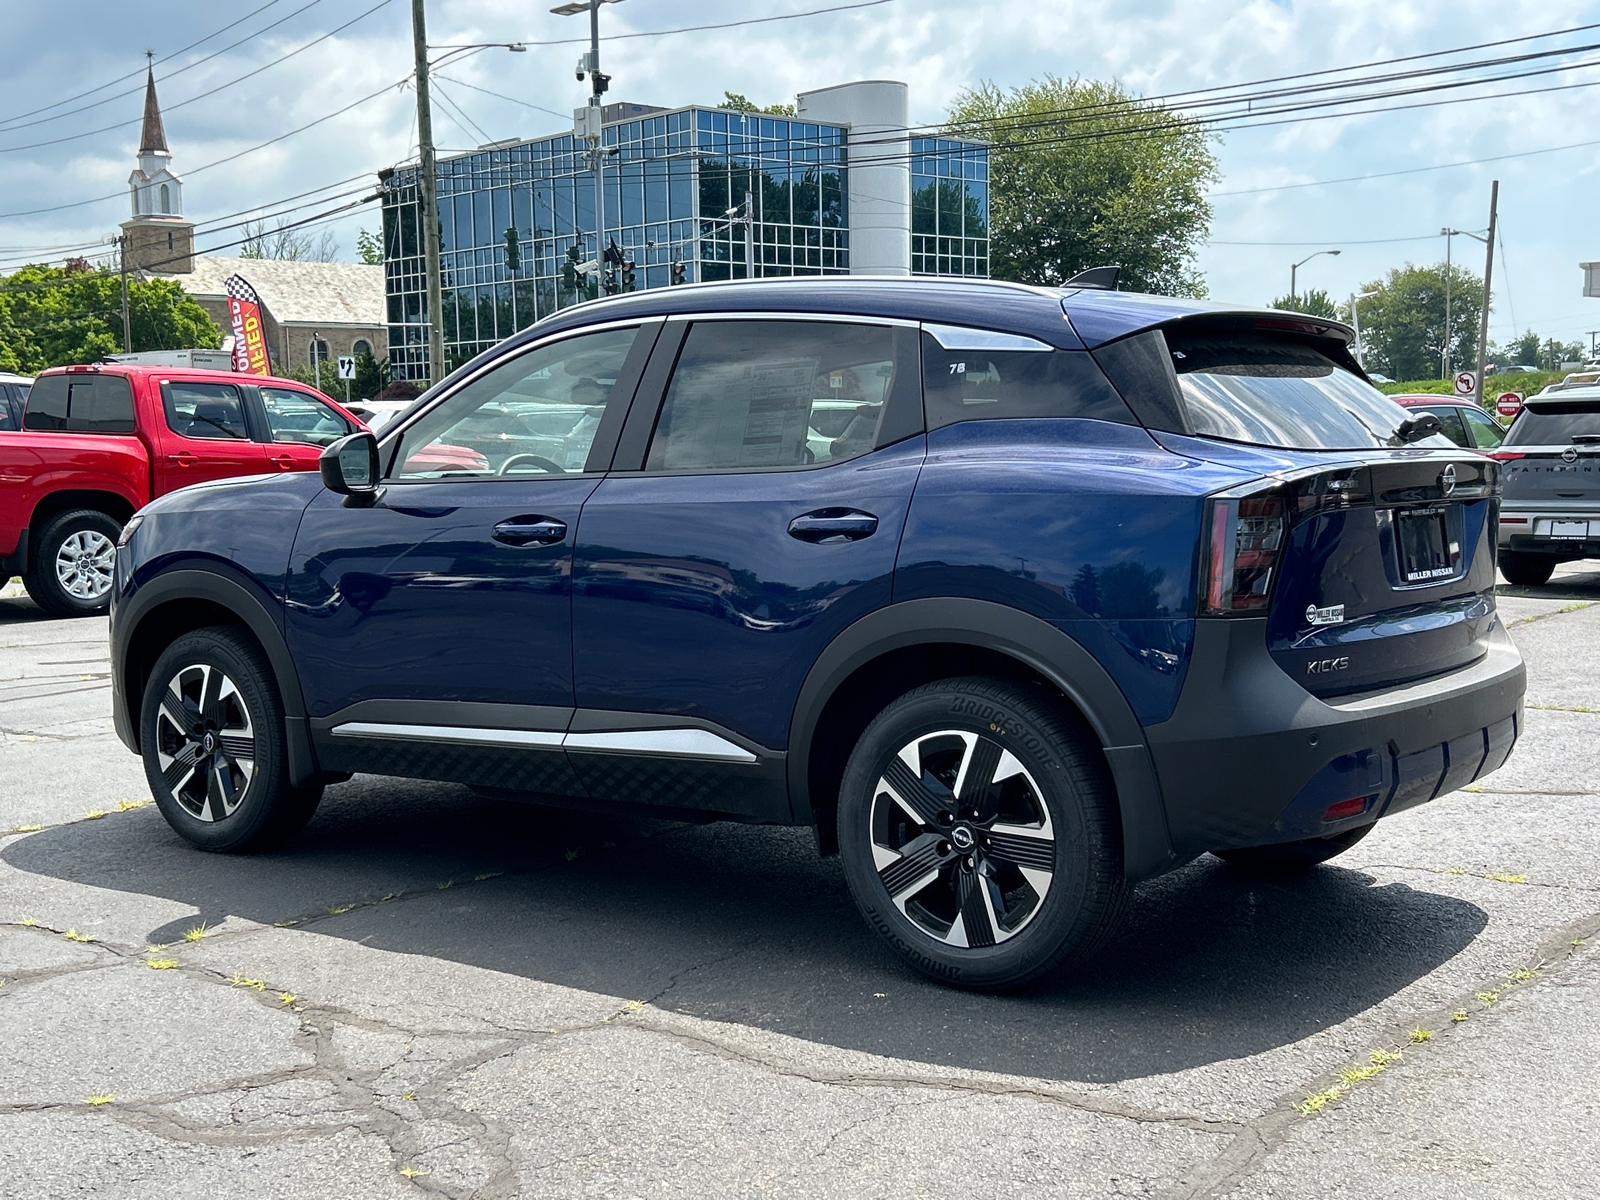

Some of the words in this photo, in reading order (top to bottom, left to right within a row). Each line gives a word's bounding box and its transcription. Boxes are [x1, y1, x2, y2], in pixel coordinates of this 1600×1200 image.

[1407, 570, 1431, 581] MILLER
[1431, 567, 1453, 577] NISSAN
[1306, 656, 1349, 675] KICKS
[238, 672, 268, 765] BRIDGESTONE
[949, 697, 1057, 772] BRIDGESTONE
[864, 903, 962, 979] BRIDGESTONE
